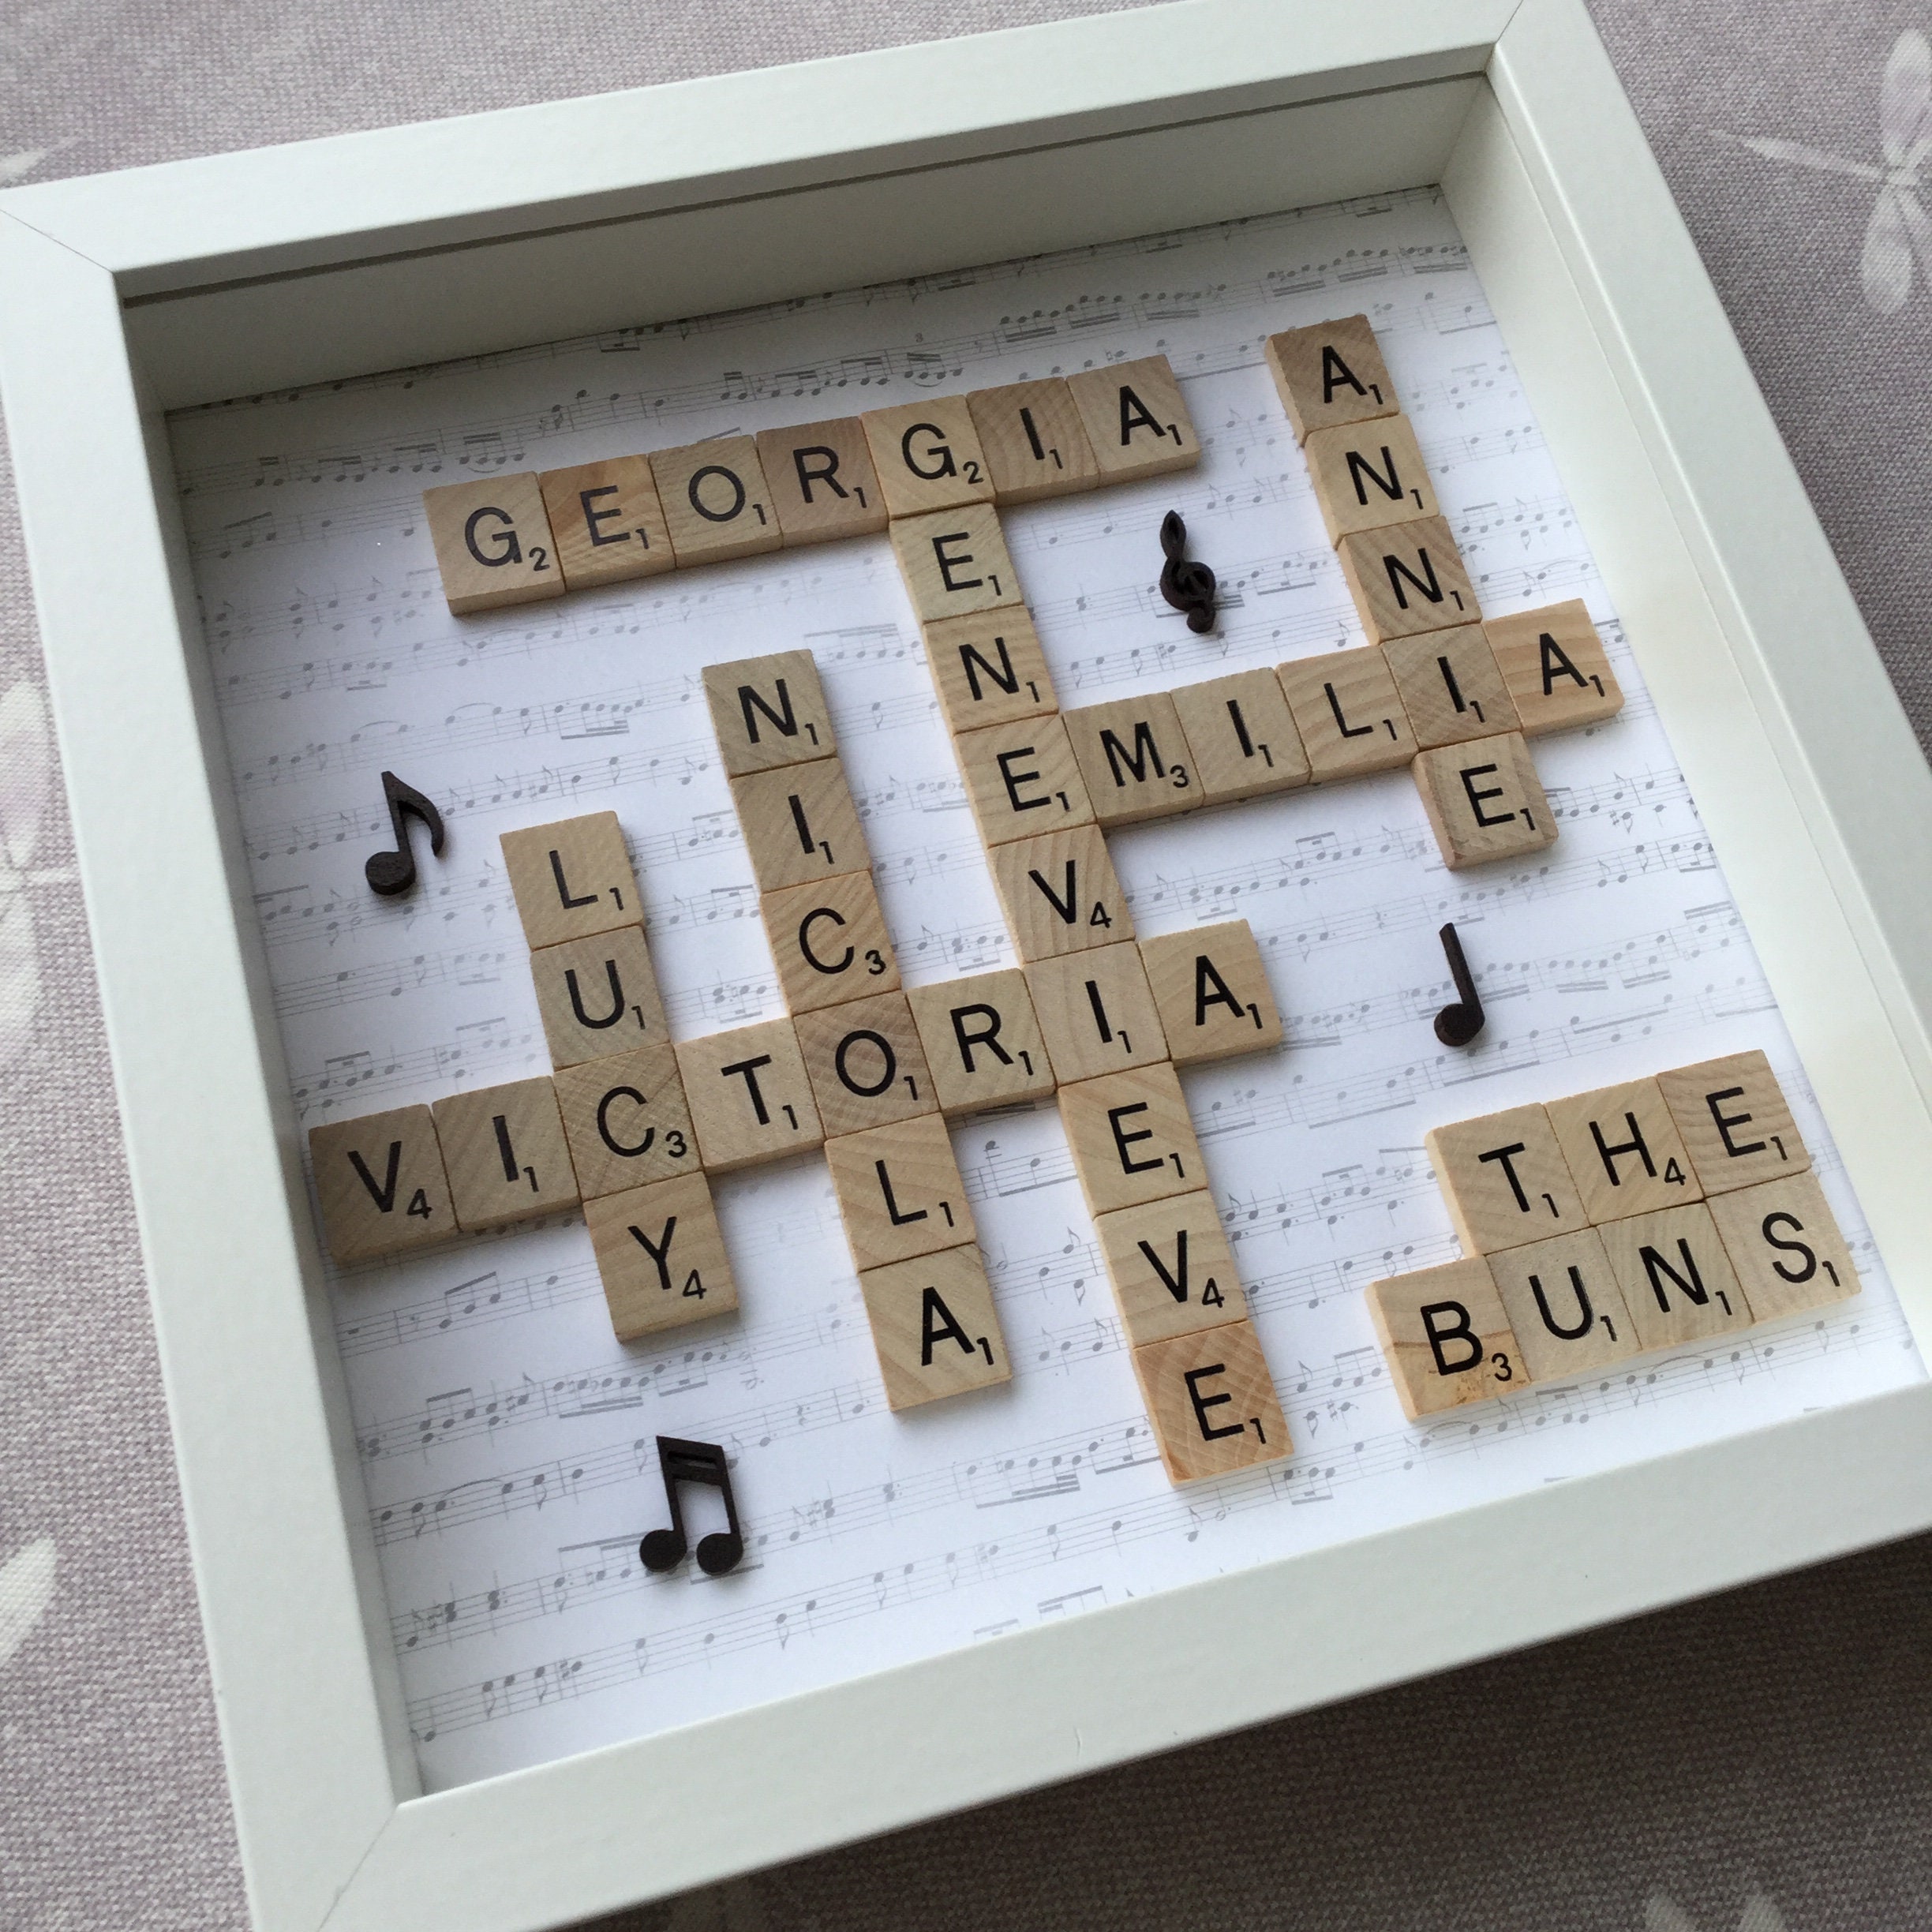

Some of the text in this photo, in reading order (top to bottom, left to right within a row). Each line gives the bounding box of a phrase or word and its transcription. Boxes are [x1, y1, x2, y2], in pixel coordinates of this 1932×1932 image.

[465, 386, 1166, 567] GEORGIA
[1321, 345, 1516, 828] ANNIE
[996, 632, 1589, 812] EMILIA
[737, 678, 976, 1367] NICOLA
[901, 422, 1246, 1443] GENEVIEVE
[349, 955, 1246, 1215] VICTORIA
[549, 850, 677, 1290] LUCY
[1477, 1086, 1767, 1213] THE
[1420, 1211, 1817, 1376] BUNS
